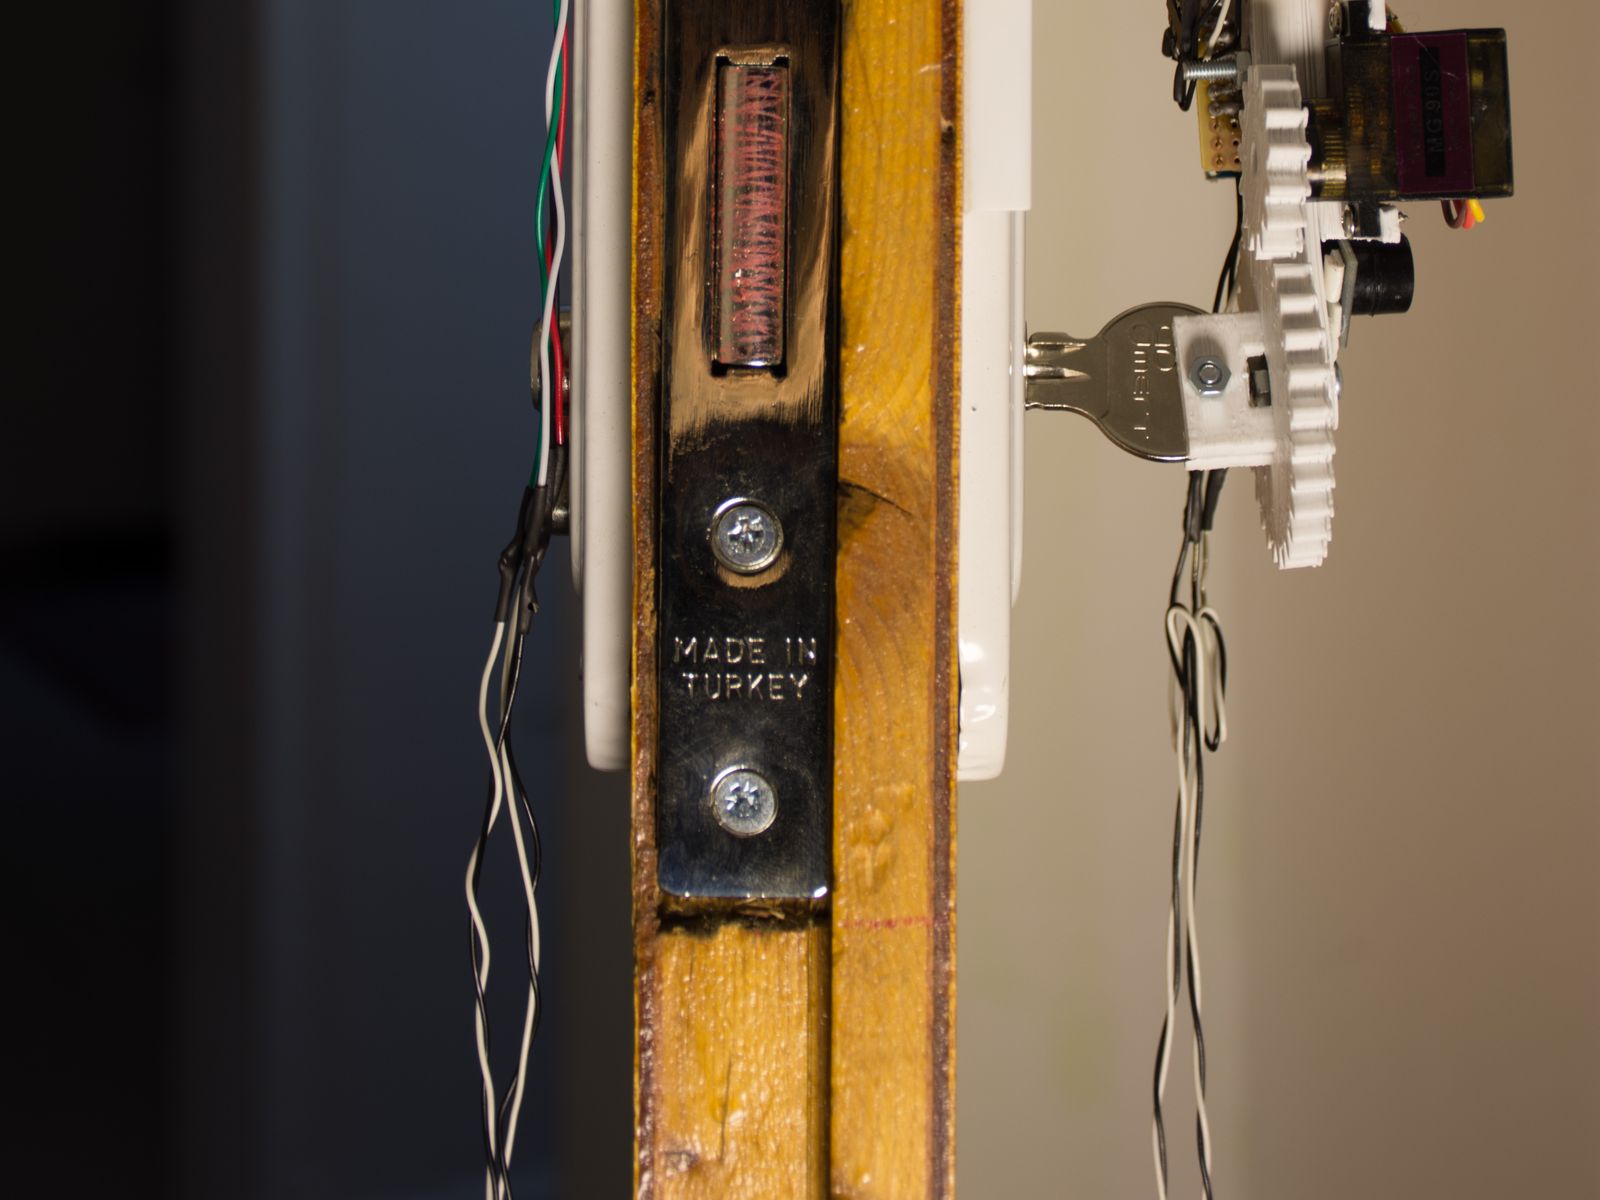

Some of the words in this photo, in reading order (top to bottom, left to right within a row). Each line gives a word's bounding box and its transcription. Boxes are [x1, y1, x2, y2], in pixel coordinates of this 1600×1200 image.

[673, 637, 765, 664] MADE
[786, 637, 816, 665] IN
[682, 673, 807, 700] TURKEY
